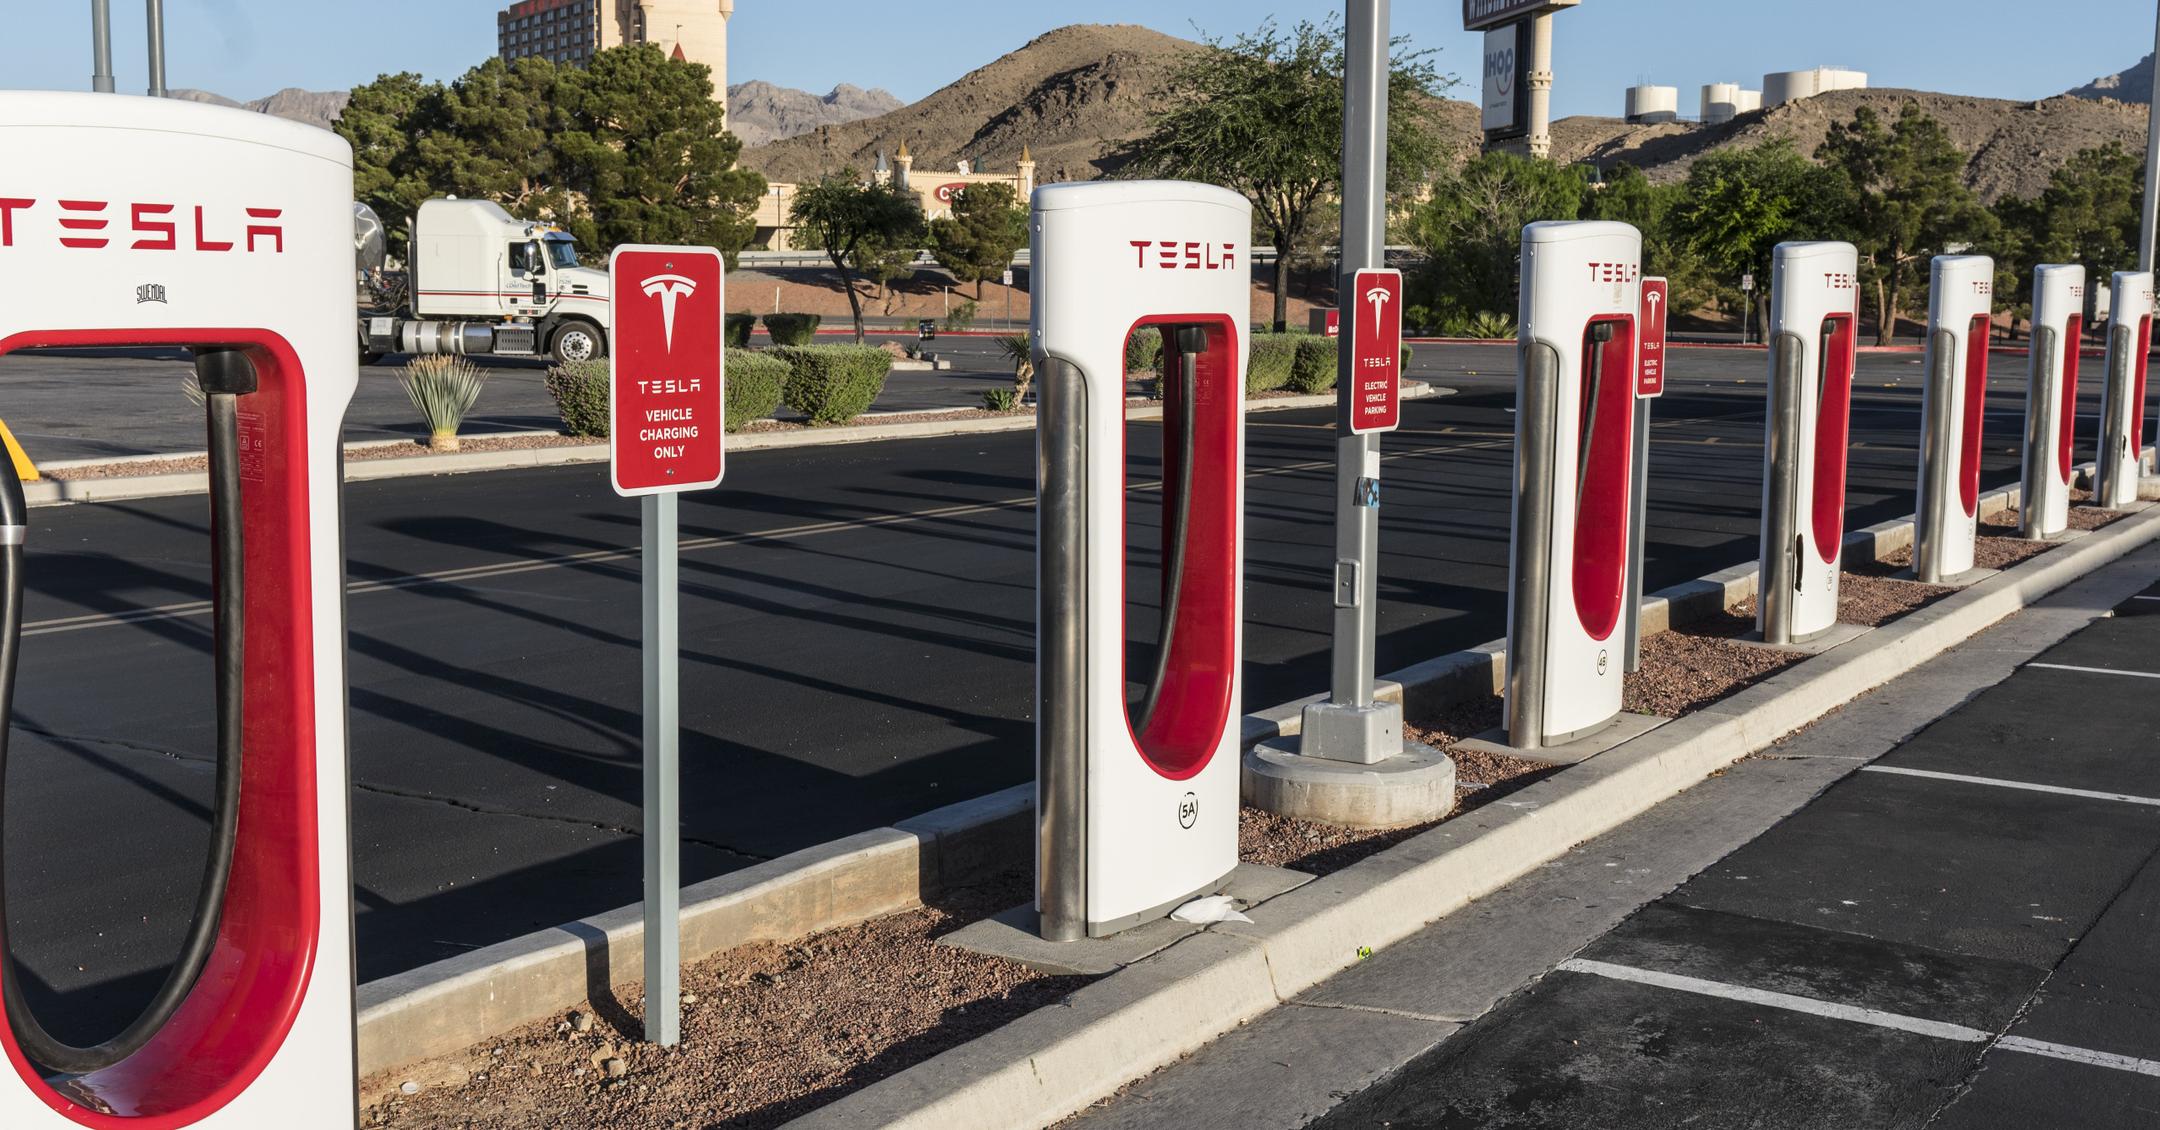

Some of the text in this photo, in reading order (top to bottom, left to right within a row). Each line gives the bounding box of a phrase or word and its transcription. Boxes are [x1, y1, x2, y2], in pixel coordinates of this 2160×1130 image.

[0, 197, 284, 253] TESLA
[1129, 240, 1235, 270] TESLA
[1588, 262, 1637, 282] TESLA
[1363, 356, 1391, 367] TESLA
[637, 378, 701, 394] TESLA
[1364, 380, 1388, 390] ELECTRIC
[1365, 393, 1387, 403] VEHICLE
[645, 408, 693, 422] VEHICLE
[1364, 405, 1387, 415] PARKING
[639, 426, 699, 441] CHARGING
[653, 445, 685, 459] ONLY
[1182, 801, 1196, 819] 5A
